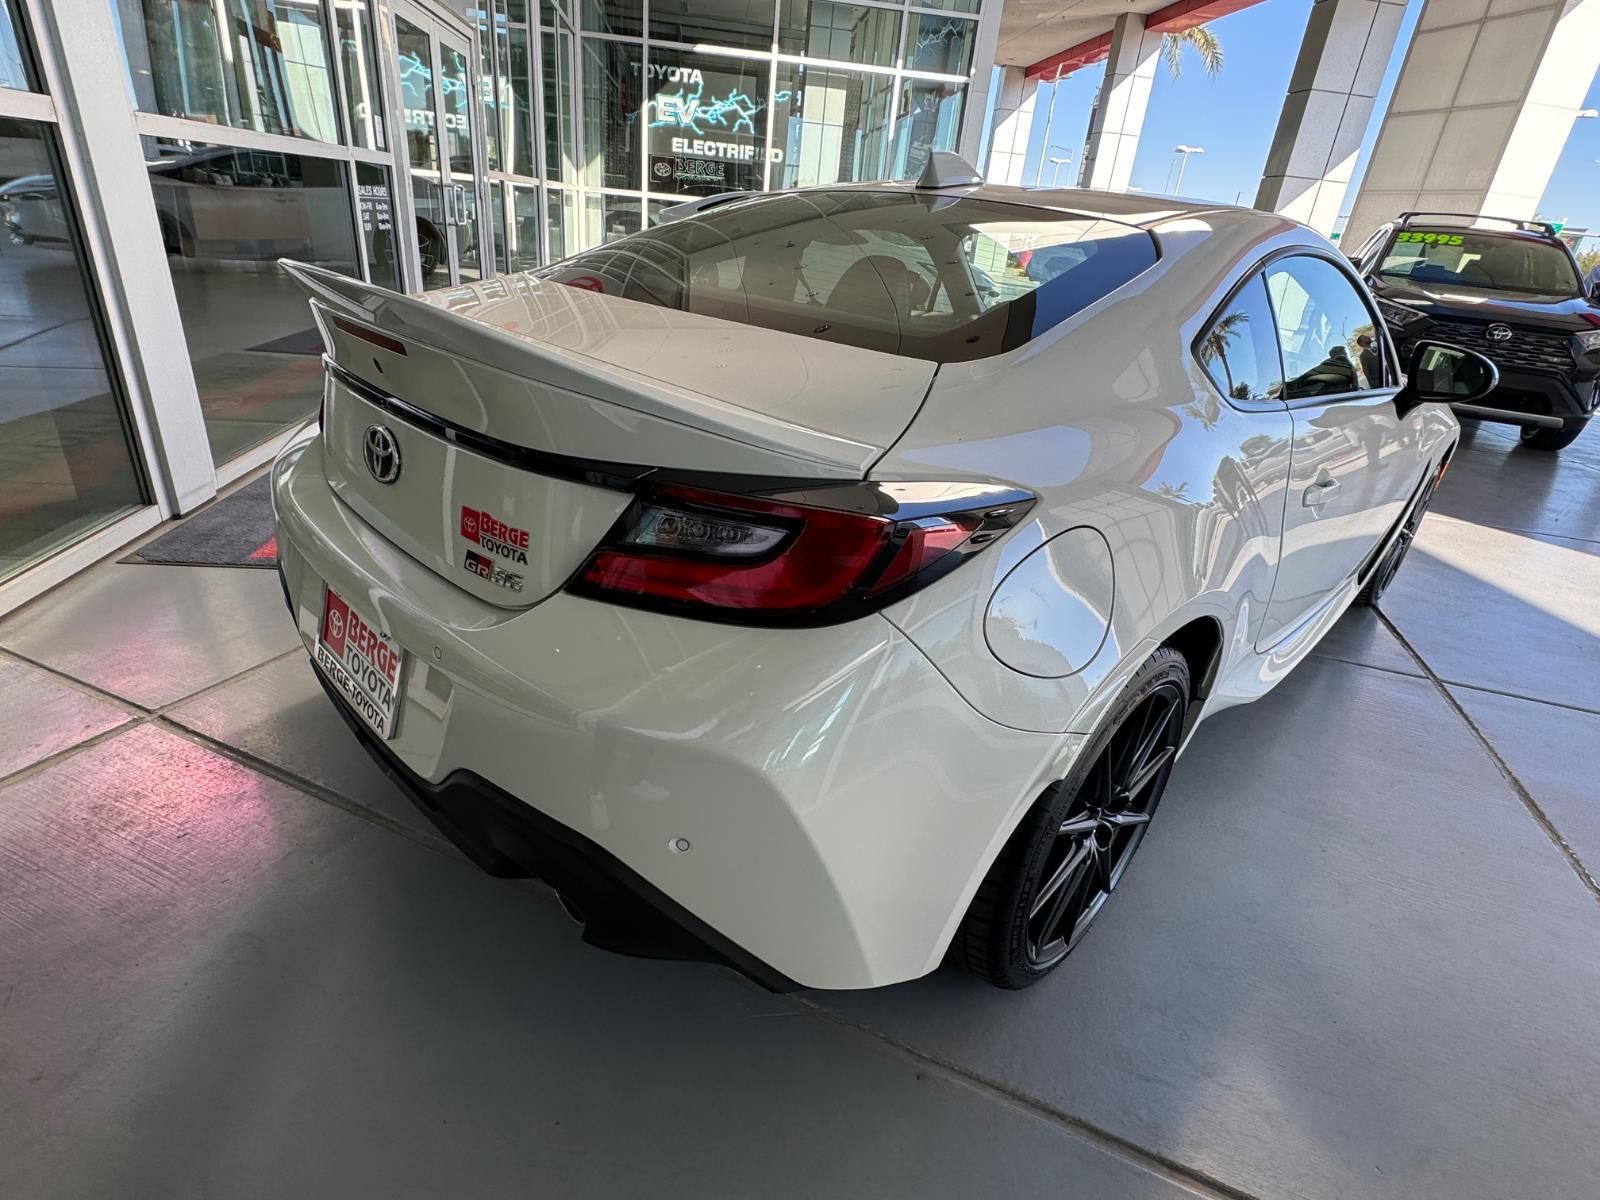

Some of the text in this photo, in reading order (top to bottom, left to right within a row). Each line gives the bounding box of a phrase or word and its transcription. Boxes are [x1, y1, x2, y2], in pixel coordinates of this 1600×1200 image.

[656, 95, 699, 124] EV
[675, 156, 725, 177] BERGE
[1396, 232, 1464, 245] 33995
[480, 511, 529, 549] BERGE
[480, 535, 528, 566] TOYOTA
[348, 610, 398, 684] BERGE
[345, 643, 392, 712] TOYOTA
